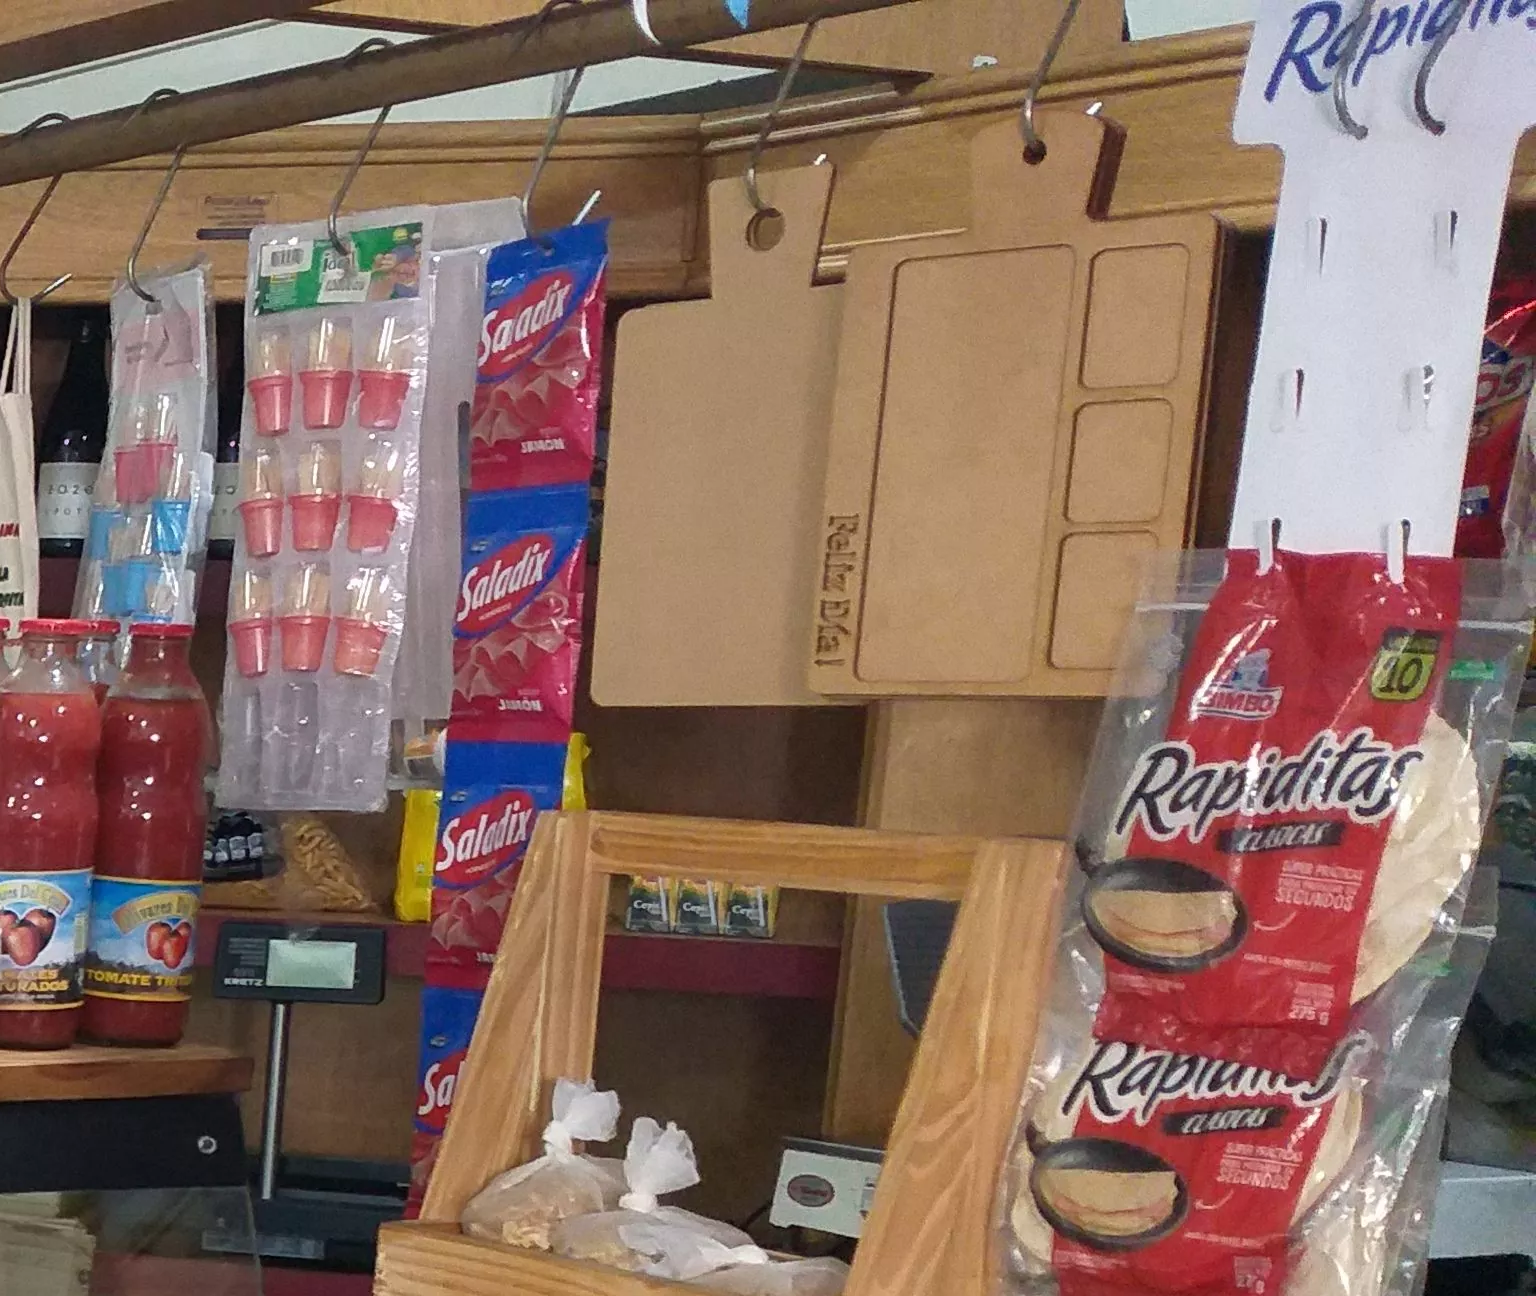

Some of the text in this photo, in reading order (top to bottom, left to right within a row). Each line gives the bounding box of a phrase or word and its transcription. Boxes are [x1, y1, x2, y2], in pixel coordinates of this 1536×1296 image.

[457, 545, 549, 620] Saladix
[1381, 657, 1425, 695] 10
[1110, 728, 1426, 843] Rapiditas
[435, 800, 534, 874] Saladix
[88, 969, 150, 987] TOMATE
